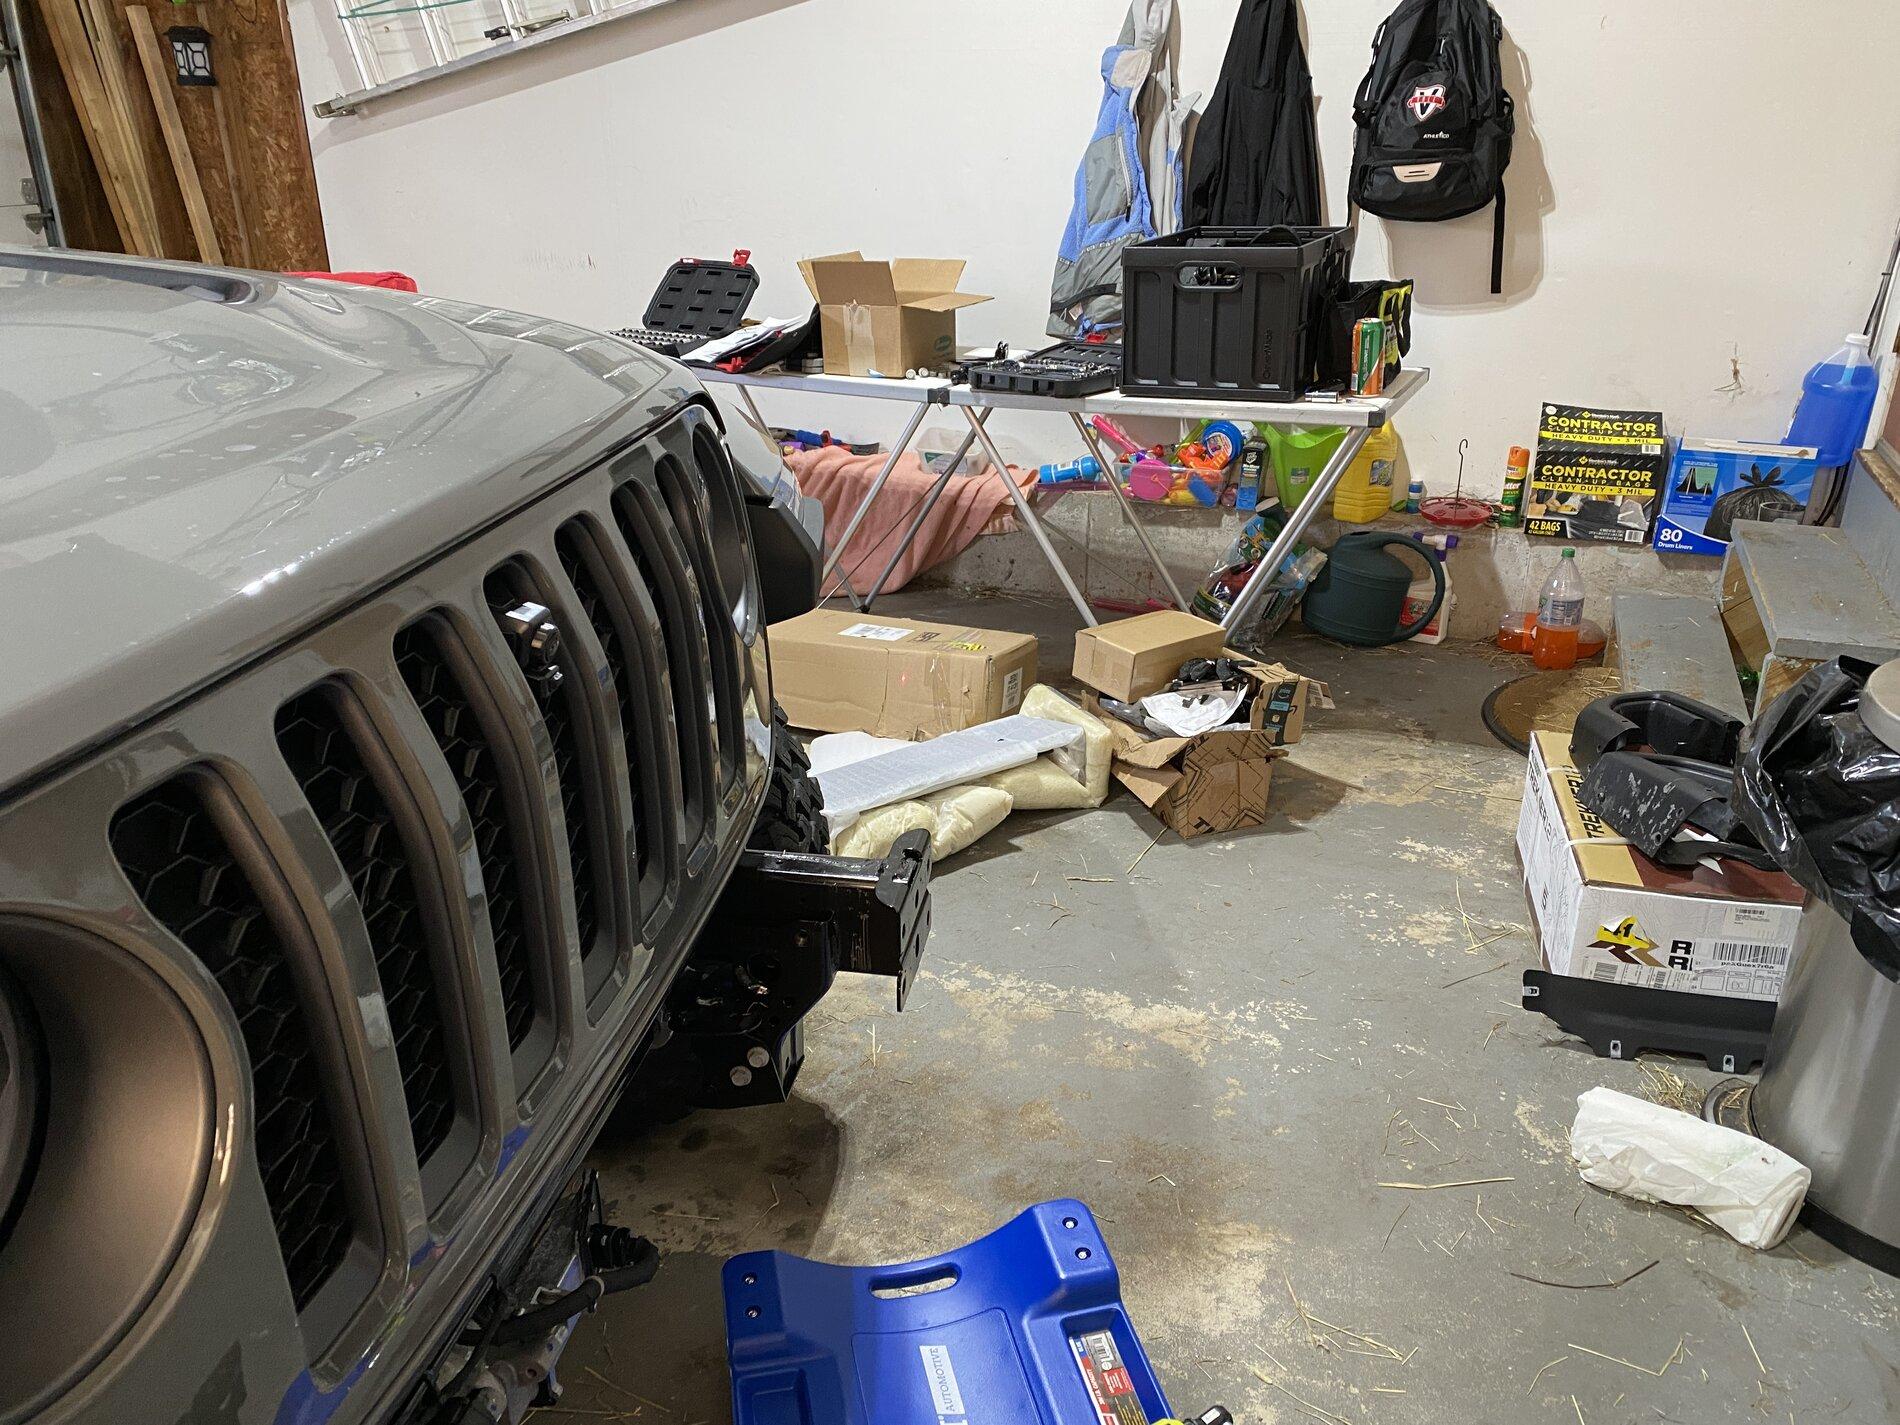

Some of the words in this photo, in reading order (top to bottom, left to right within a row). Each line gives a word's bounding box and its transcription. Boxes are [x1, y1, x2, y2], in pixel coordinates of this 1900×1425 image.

[1548, 416, 1657, 432] CONTRACTOR
[1541, 464, 1652, 482] CONTRACTOR
[1544, 483, 1578, 491] HEAVY
[1616, 480, 1651, 488] BAGS
[1529, 520, 1540, 530] 42
[1540, 521, 1561, 531] BAGS
[1660, 528, 1683, 542] 80
[1658, 541, 1675, 549] Drum
[1675, 542, 1693, 550] Liners
[929, 1347, 956, 1412] AUTOMOTIVE
